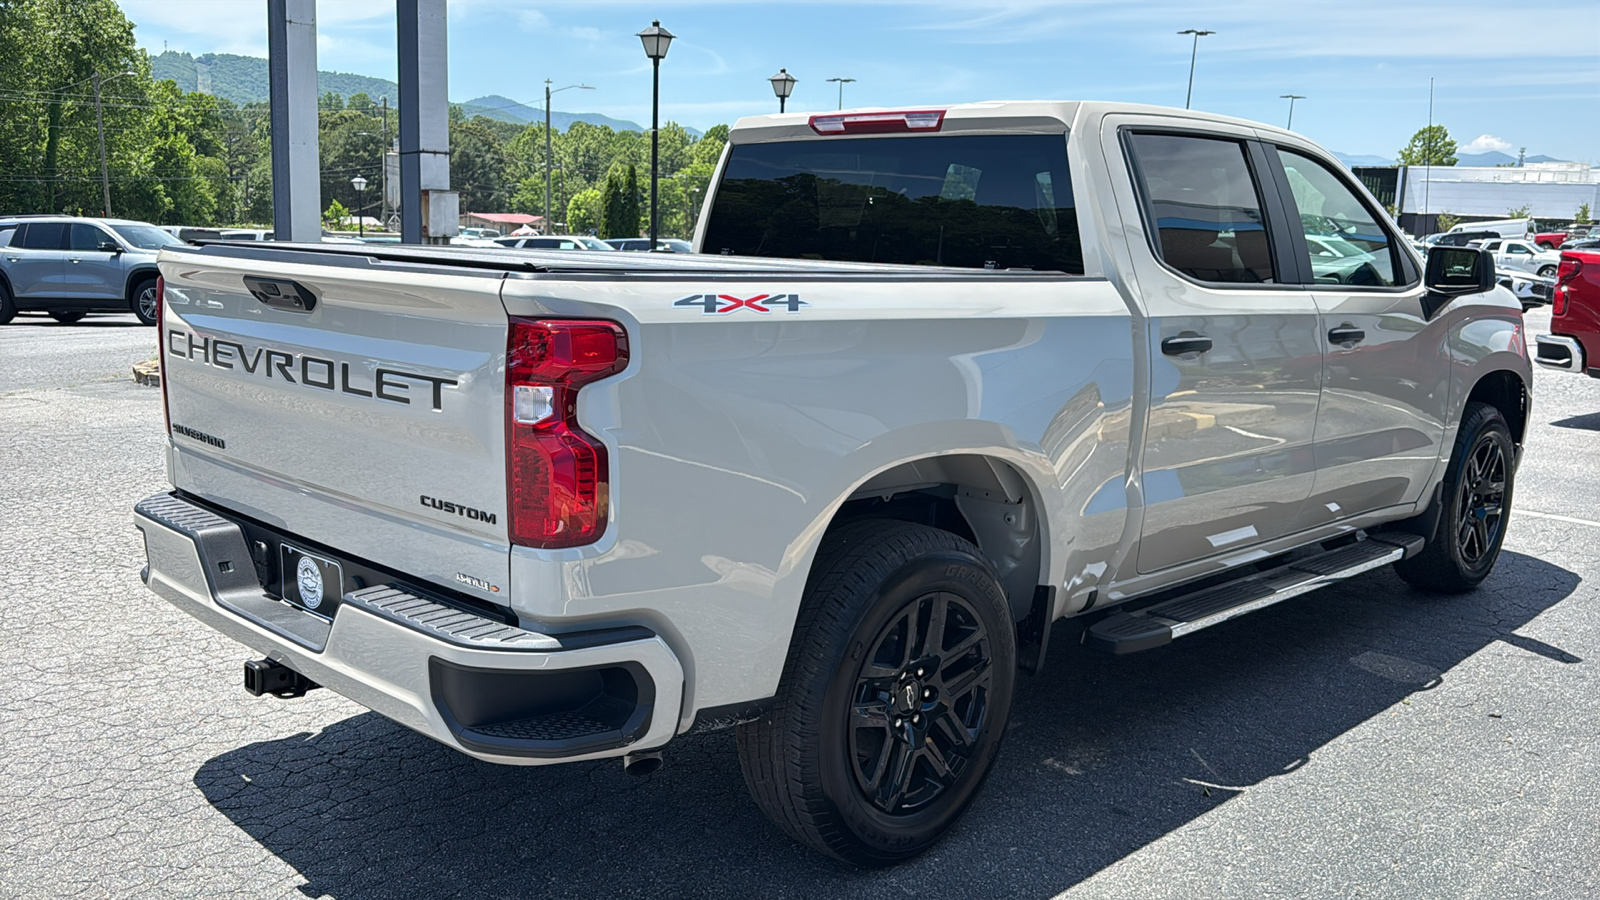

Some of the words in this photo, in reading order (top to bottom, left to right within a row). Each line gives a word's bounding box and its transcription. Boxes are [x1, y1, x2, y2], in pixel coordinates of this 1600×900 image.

[168, 330, 458, 411] CHEVROLET
[172, 422, 226, 449] SILVERADO
[420, 495, 497, 525] CUSTOM
[945, 564, 1007, 623] GRABBER
